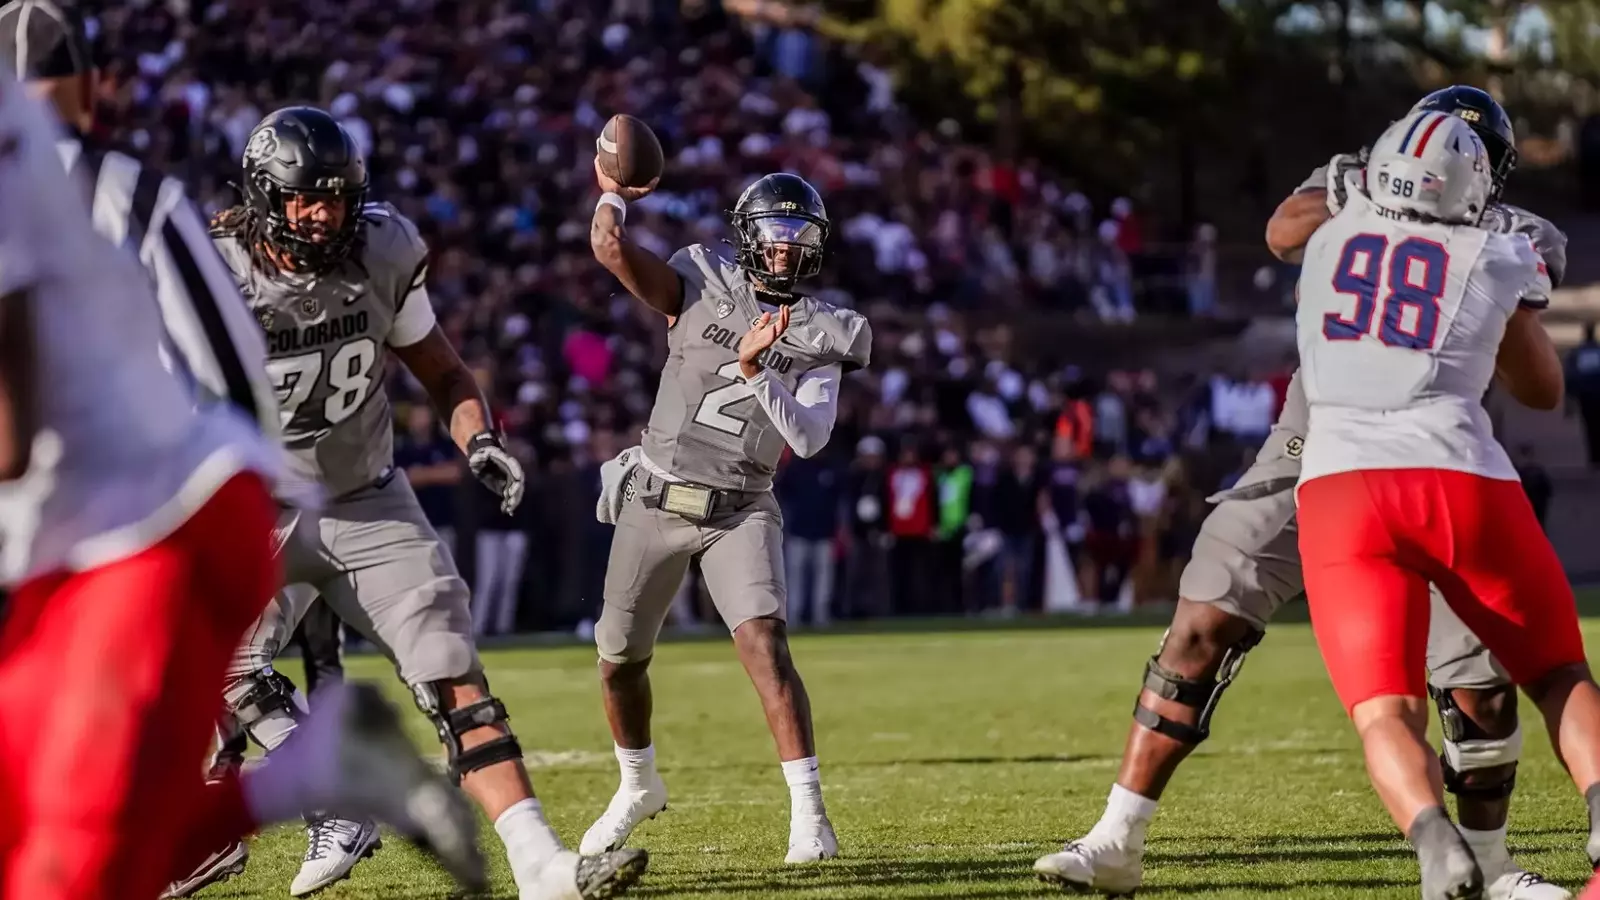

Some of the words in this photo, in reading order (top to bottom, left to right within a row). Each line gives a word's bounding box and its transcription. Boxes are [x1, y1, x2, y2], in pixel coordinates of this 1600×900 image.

[1391, 177, 1414, 198] 98
[1322, 233, 1450, 351] 98
[264, 336, 377, 430] 78
[701, 323, 794, 374] COLADO
[692, 359, 757, 437] 2
